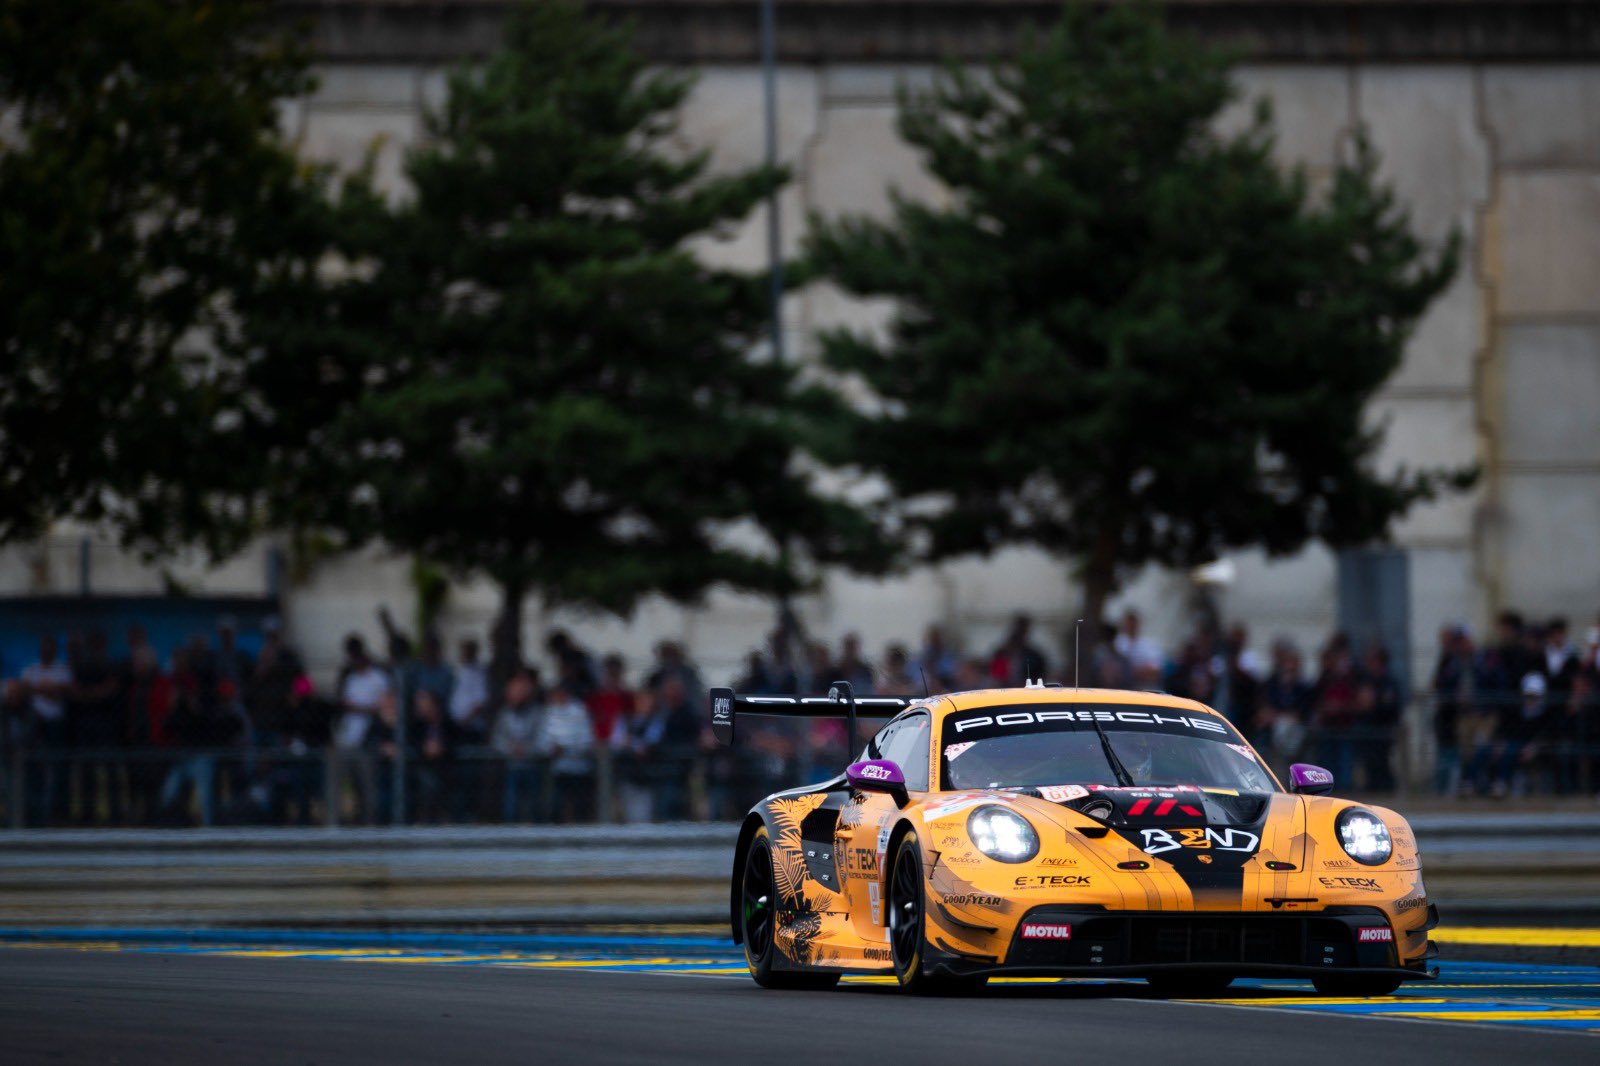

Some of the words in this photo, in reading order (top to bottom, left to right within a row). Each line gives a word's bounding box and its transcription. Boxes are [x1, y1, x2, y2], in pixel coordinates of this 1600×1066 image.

[954, 711, 1228, 734] PORSCHE
[1140, 828, 1260, 854] BEND
[1041, 857, 1078, 866] ENDLESS
[943, 894, 1001, 905] GOODYEAR
[1023, 925, 1069, 938] MOTUL
[1359, 928, 1392, 940] MOTUL
[864, 947, 893, 961] GOODYEA
